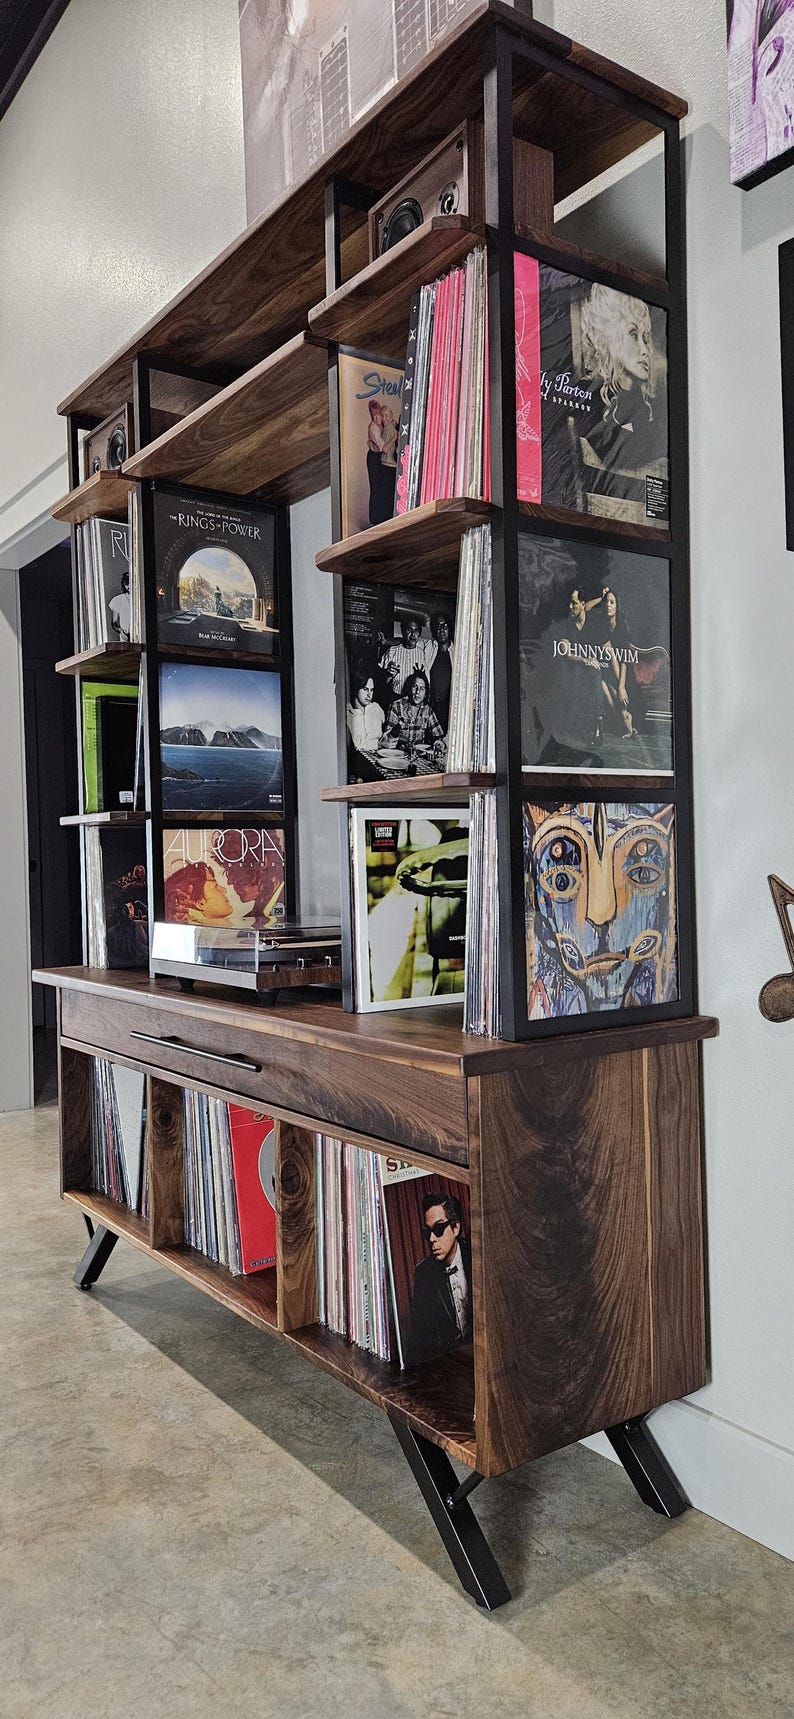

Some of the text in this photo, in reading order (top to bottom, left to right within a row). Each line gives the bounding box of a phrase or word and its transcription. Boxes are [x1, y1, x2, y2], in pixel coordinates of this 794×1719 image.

[555, 372, 592, 400] Parton
[552, 396, 591, 412] SPARROW
[178, 513, 215, 531] RINGS
[222, 521, 261, 541] POWER
[553, 640, 639, 664] JOHNNYSWIM
[163, 828, 285, 863] AURORA
[388, 1168, 420, 1181] CHRISTMAS
